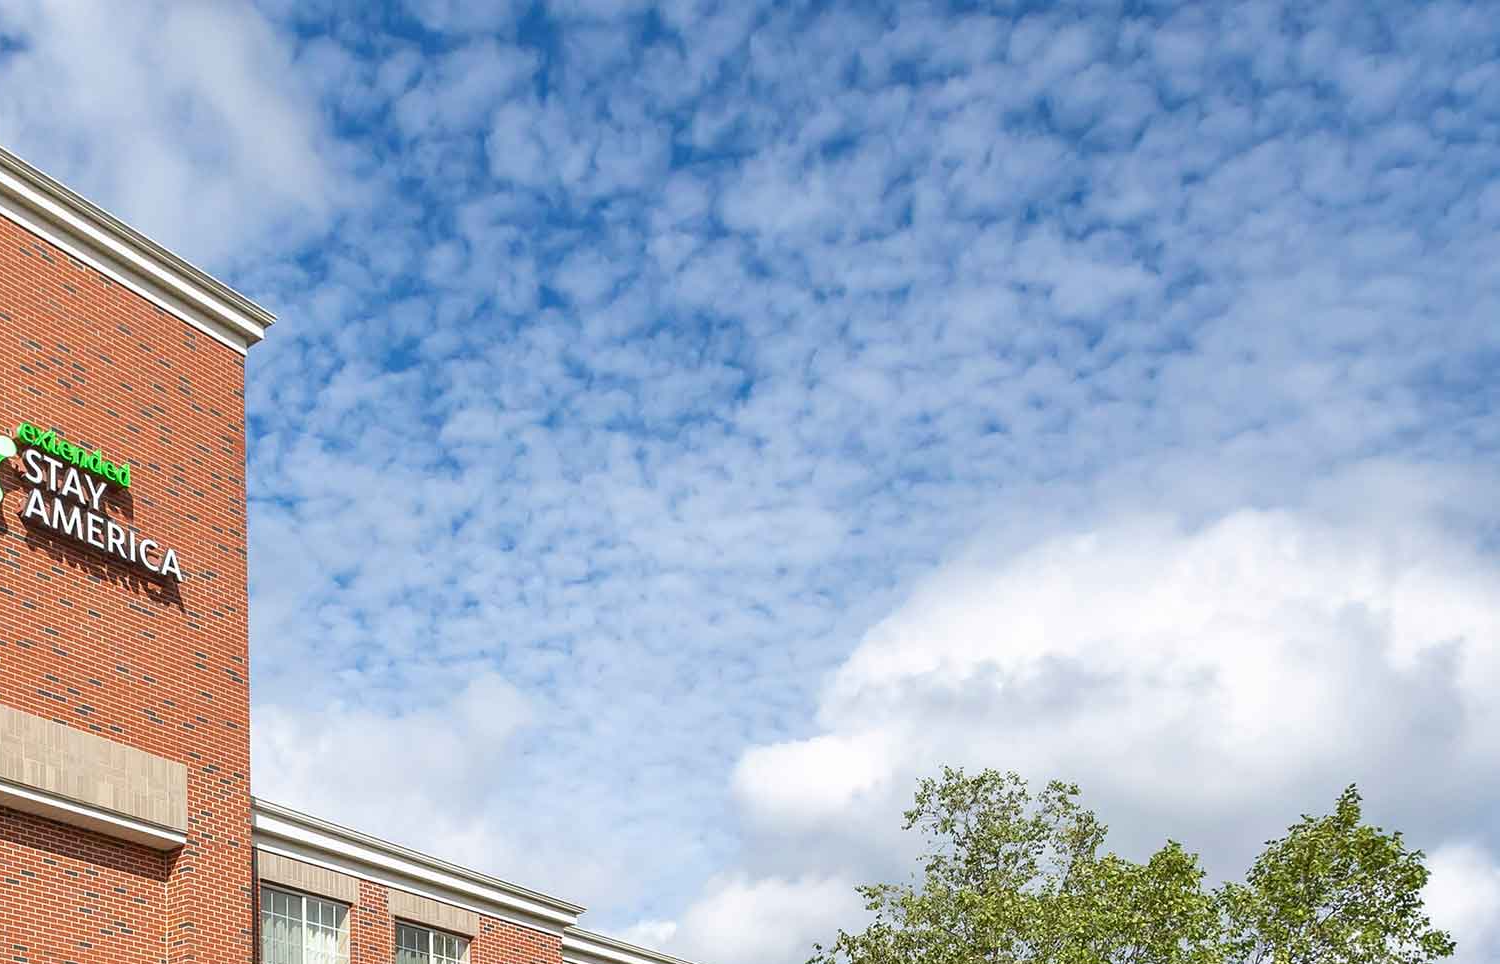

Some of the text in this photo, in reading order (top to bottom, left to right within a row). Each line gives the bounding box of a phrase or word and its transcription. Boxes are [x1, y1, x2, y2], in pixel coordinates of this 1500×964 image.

[17, 421, 131, 487] extended
[23, 450, 107, 510] STAY
[23, 489, 183, 582] AMERICA
